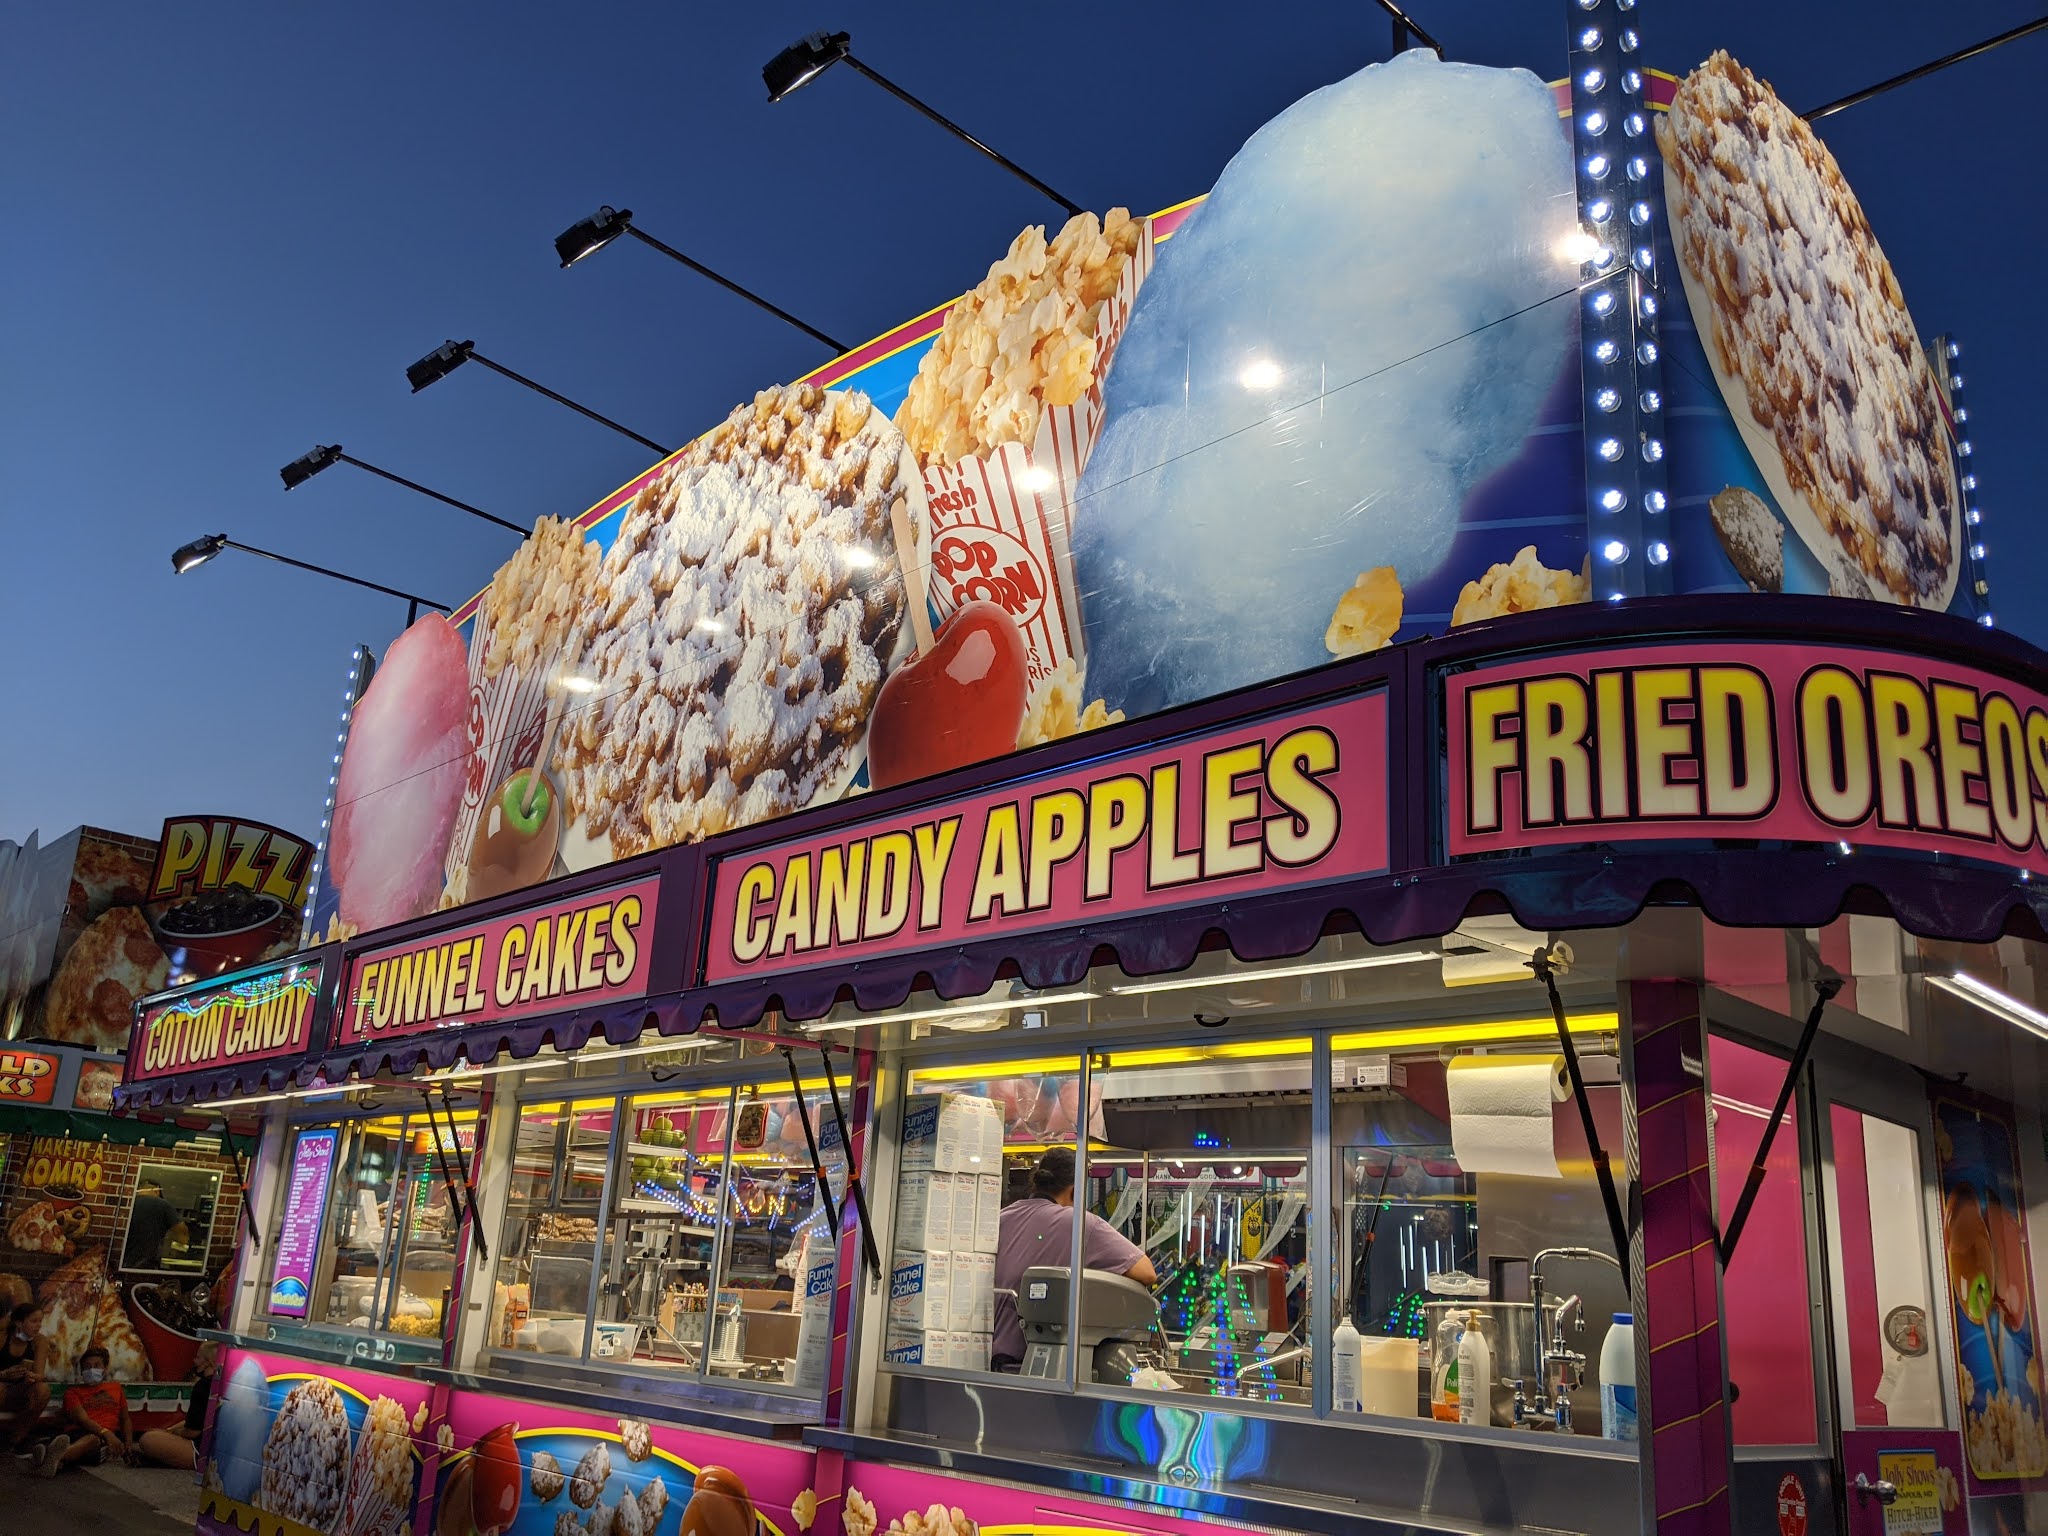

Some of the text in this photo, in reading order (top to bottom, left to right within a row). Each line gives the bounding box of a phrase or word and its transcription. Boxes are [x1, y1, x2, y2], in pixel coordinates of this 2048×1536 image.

[931, 537, 998, 586] POP
[952, 560, 1043, 616] CORN
[1463, 662, 1781, 837] FRIED
[731, 724, 1342, 965] CANDY APPLES
[352, 894, 643, 1034] FUNNEL CAKES
[143, 978, 314, 1072] COTTON CANDY
[0, 1055, 51, 1077] LD
[0, 1076, 35, 1097] KS
[30, 1136, 104, 1161] MAKE IT A
[904, 1123, 934, 1140] Cake
[23, 1157, 103, 1191] COMBO
[810, 1278, 833, 1294] Cak
[891, 1281, 920, 1298] Cake
